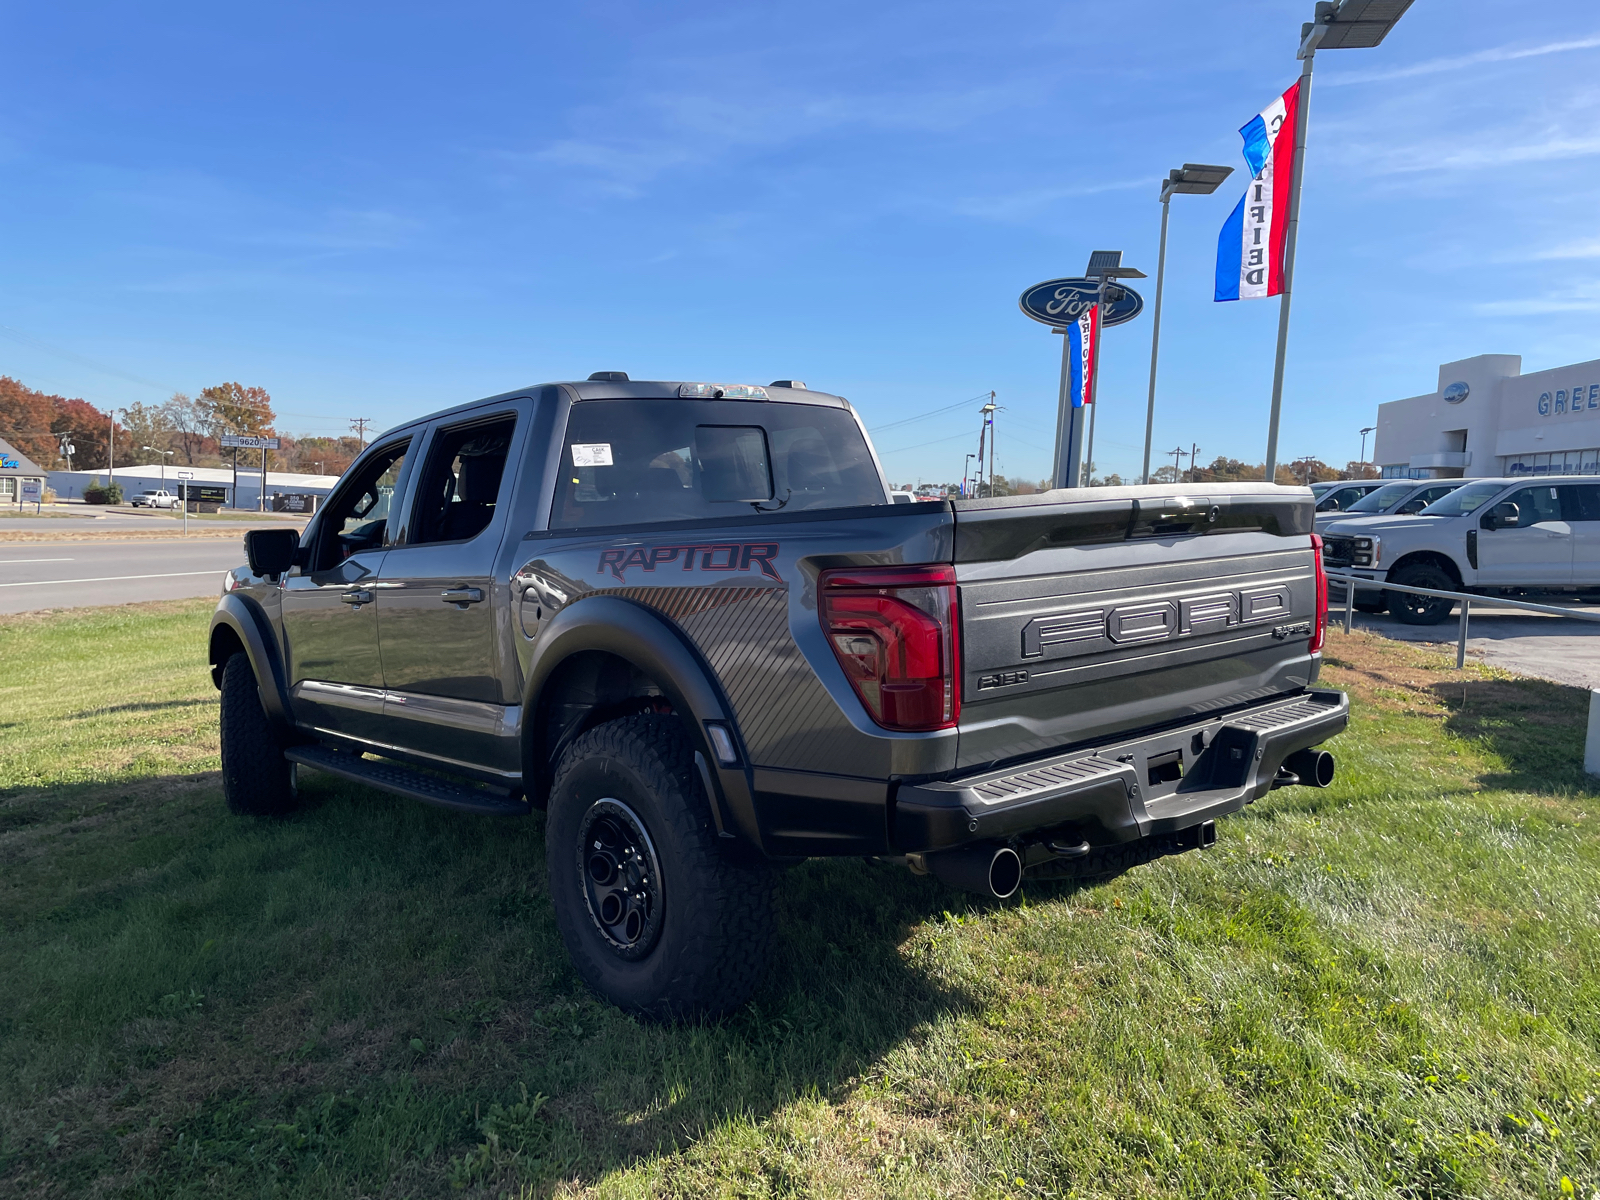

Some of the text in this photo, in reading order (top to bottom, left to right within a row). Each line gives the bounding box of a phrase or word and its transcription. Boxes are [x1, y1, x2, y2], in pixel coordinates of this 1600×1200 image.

[239, 438, 260, 447] 9620
[596, 542, 784, 585] RAPTOR
[1021, 583, 1292, 660] FORD
